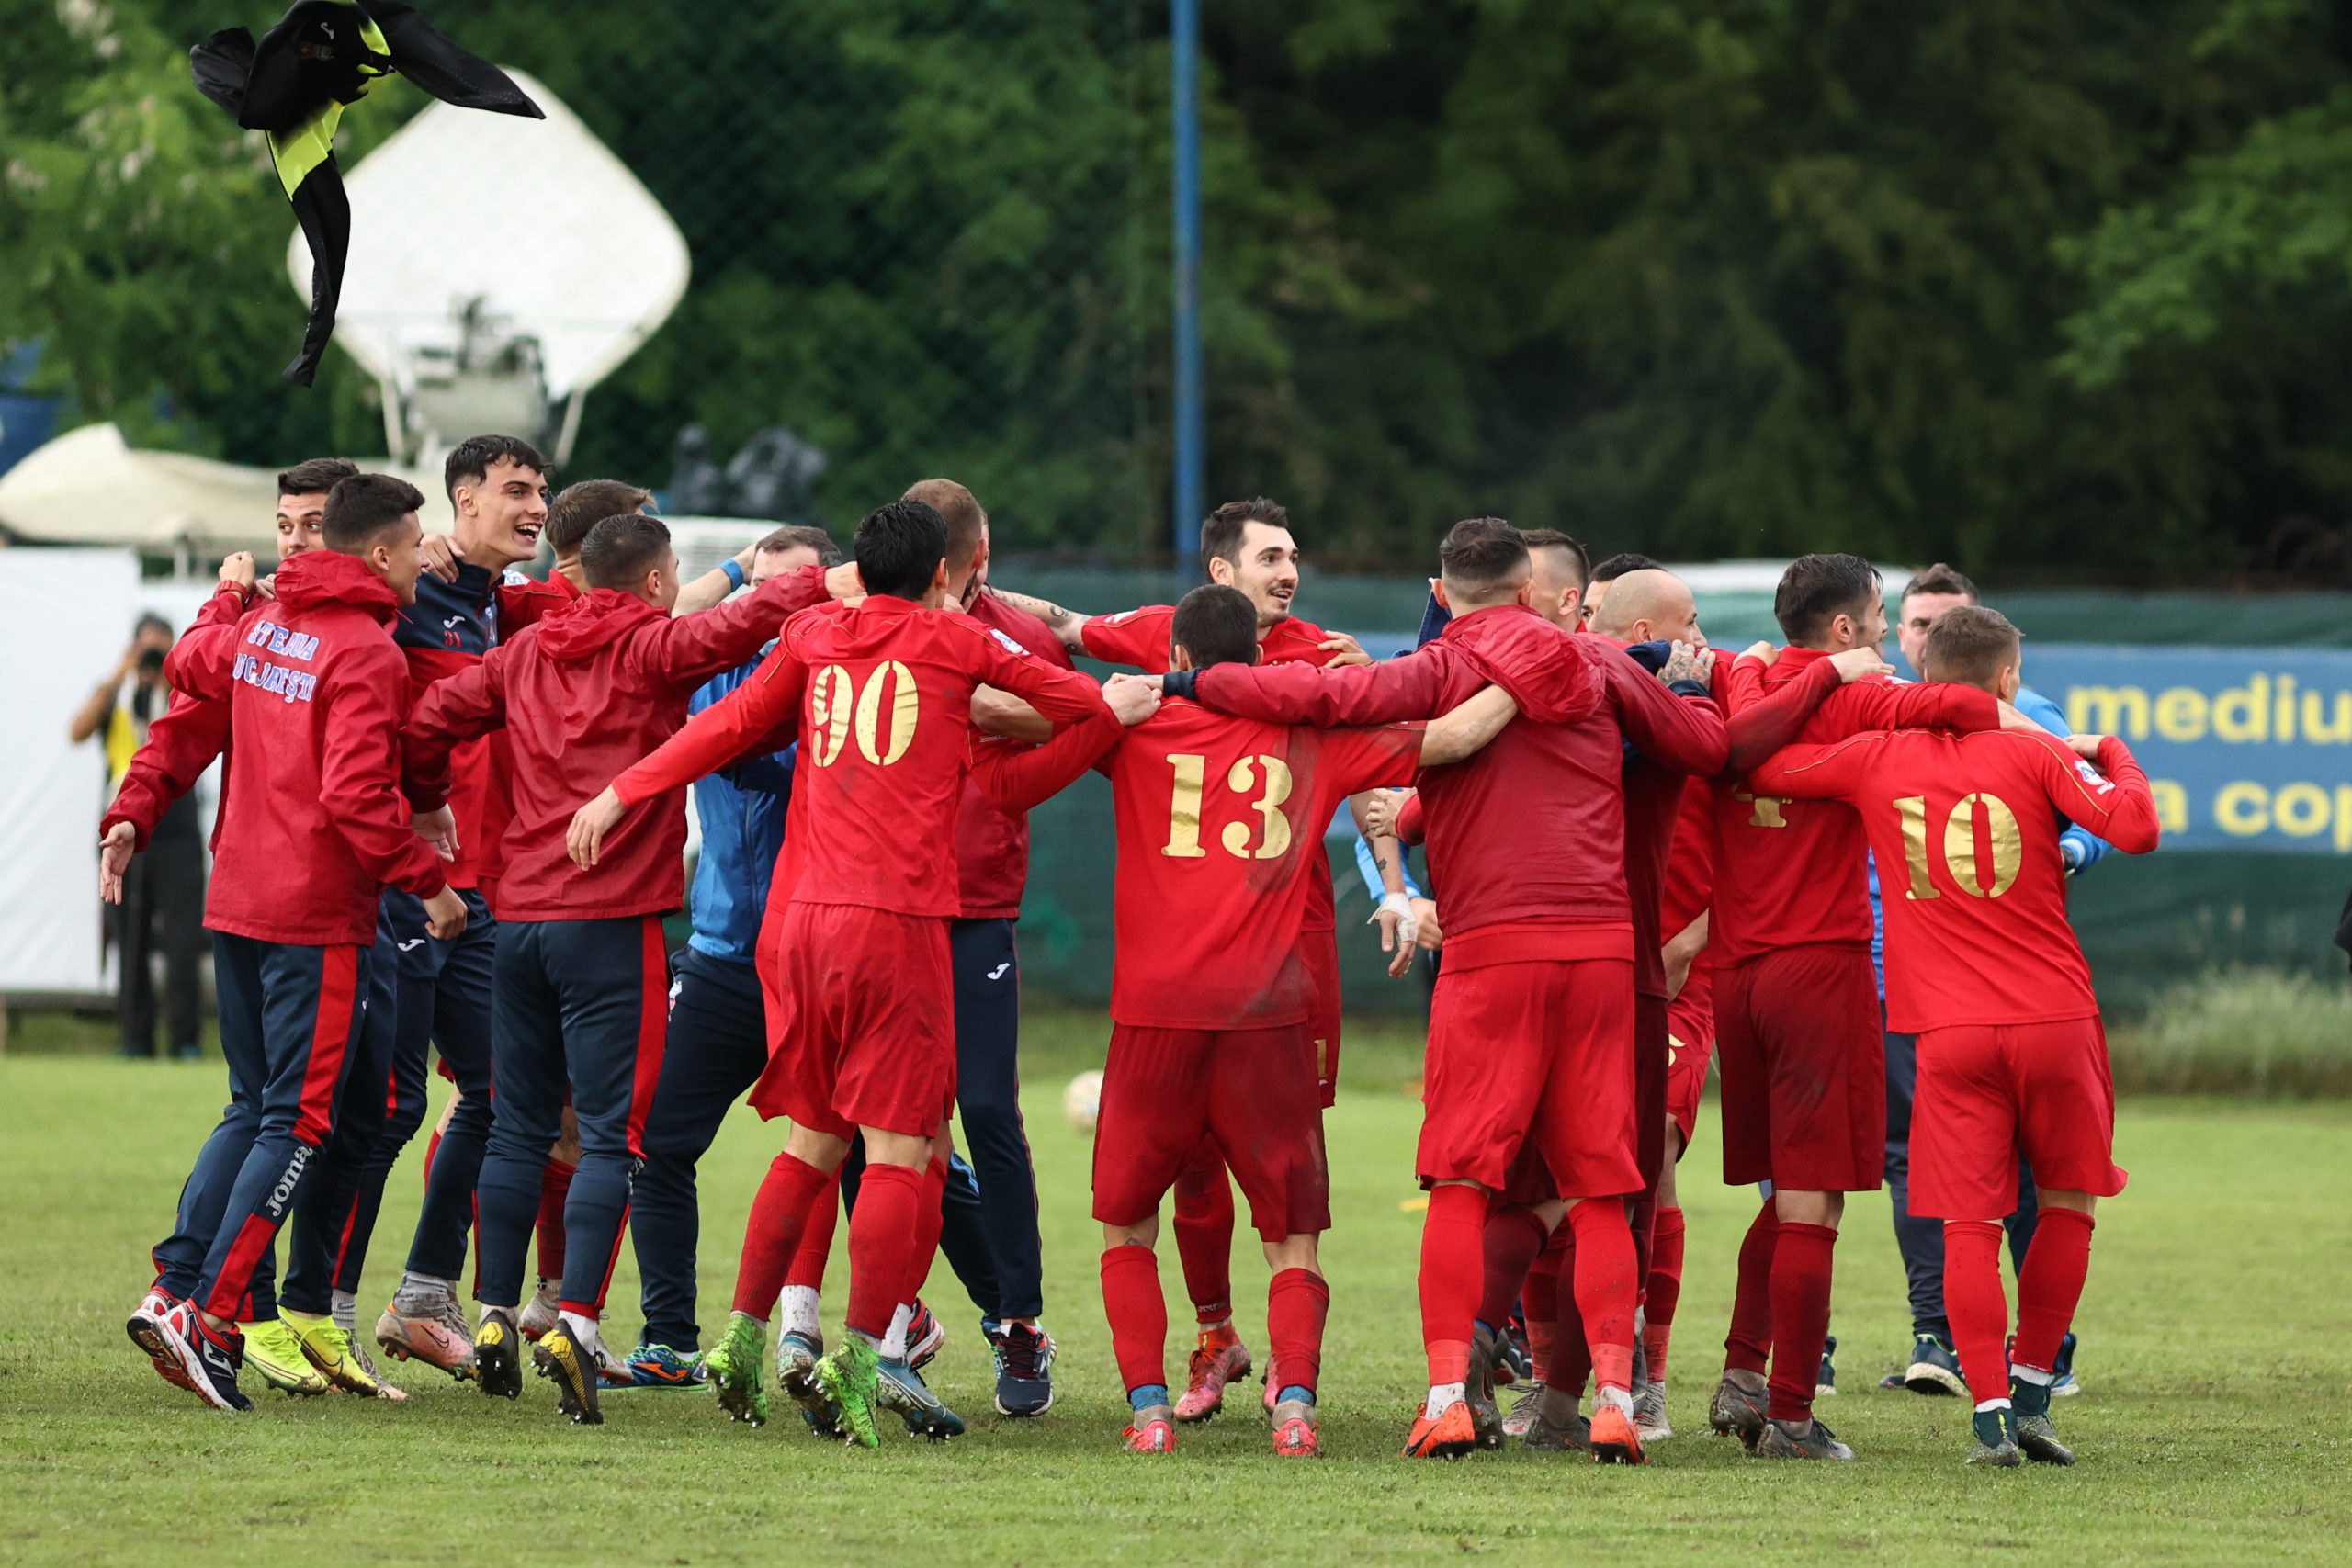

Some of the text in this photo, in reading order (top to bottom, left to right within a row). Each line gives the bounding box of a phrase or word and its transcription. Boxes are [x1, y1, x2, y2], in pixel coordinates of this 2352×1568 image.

[444, 630, 461, 648] 31
[812, 660, 919, 768] 90
[1161, 753, 1293, 859] 13
[1893, 792, 2022, 899] 10
